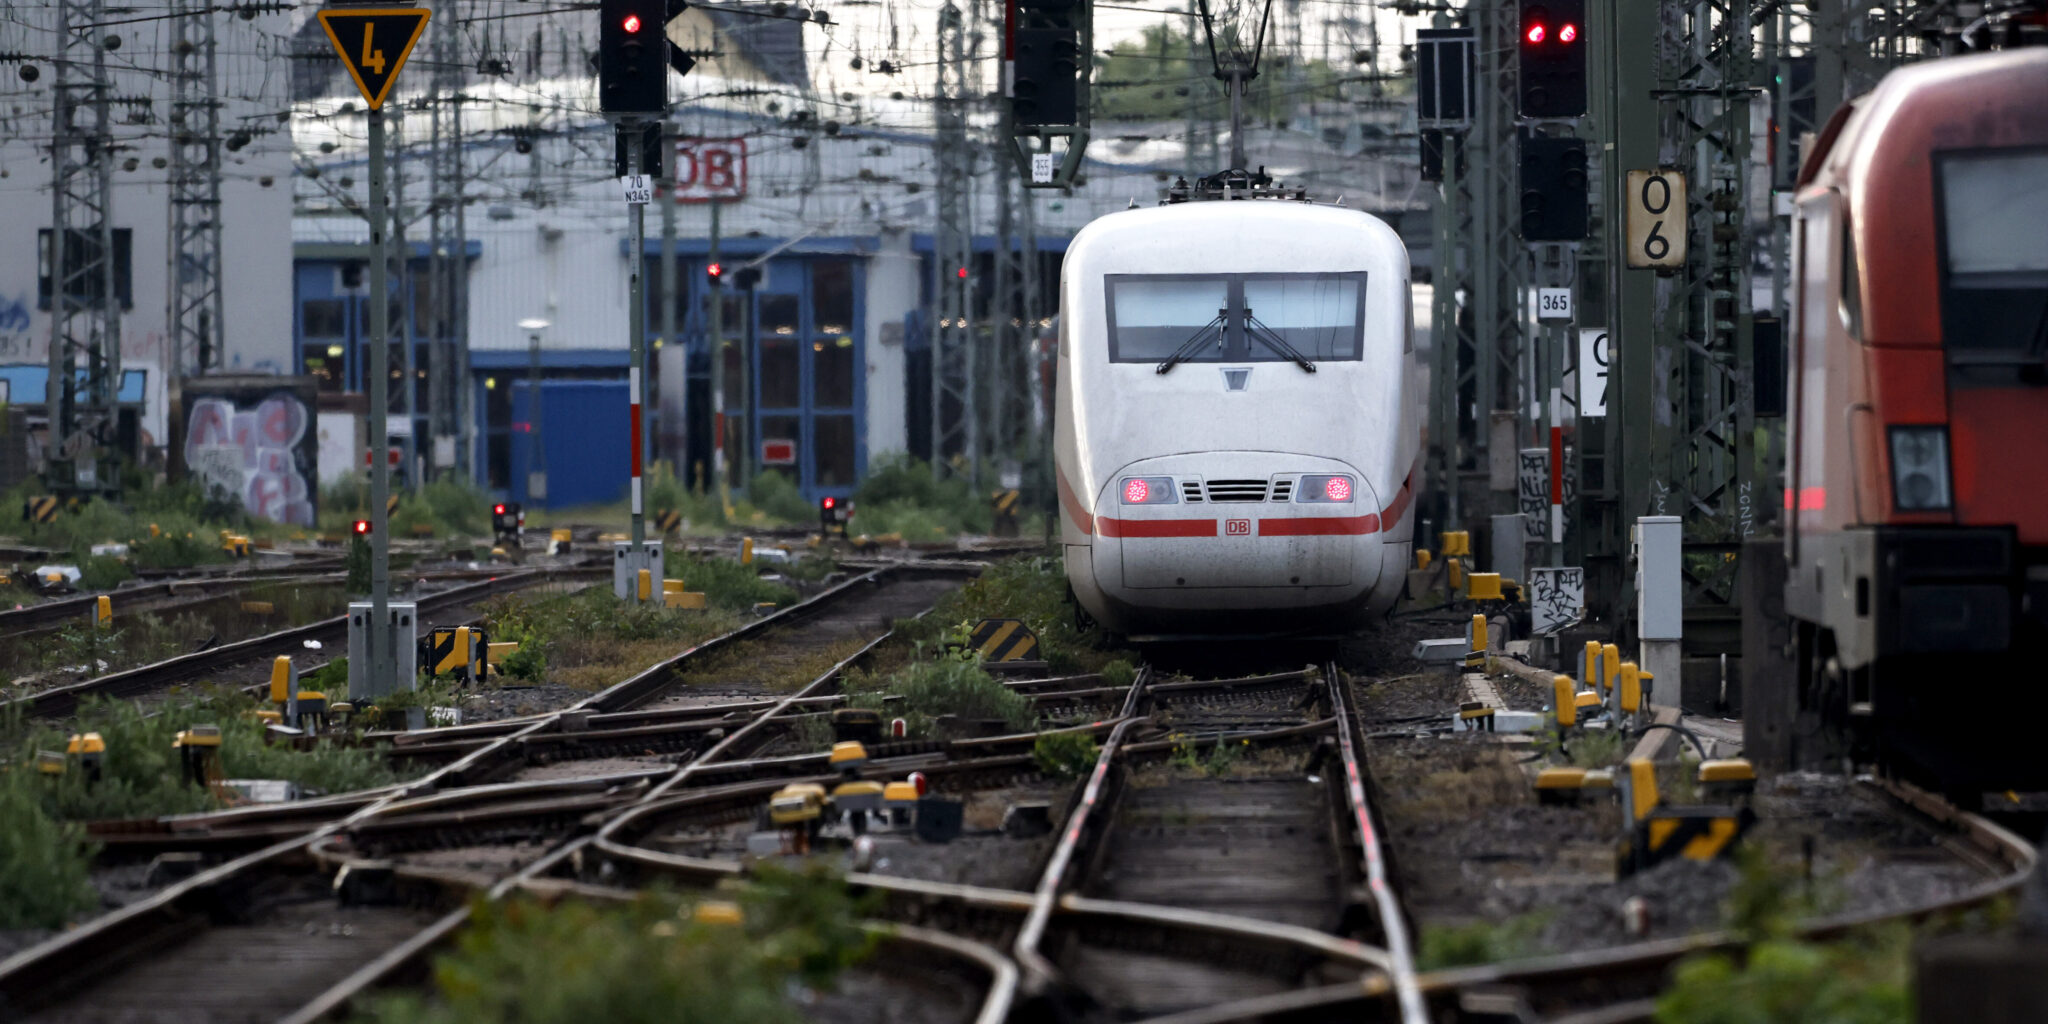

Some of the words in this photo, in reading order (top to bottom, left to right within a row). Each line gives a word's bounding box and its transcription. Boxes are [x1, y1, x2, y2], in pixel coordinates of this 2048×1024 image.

[362, 22, 386, 74] 4
[674, 149, 735, 191] DB
[629, 175, 643, 189] 70
[625, 190, 650, 202] N345
[1543, 295, 1568, 311] 365
[1228, 521, 1248, 533] DB
